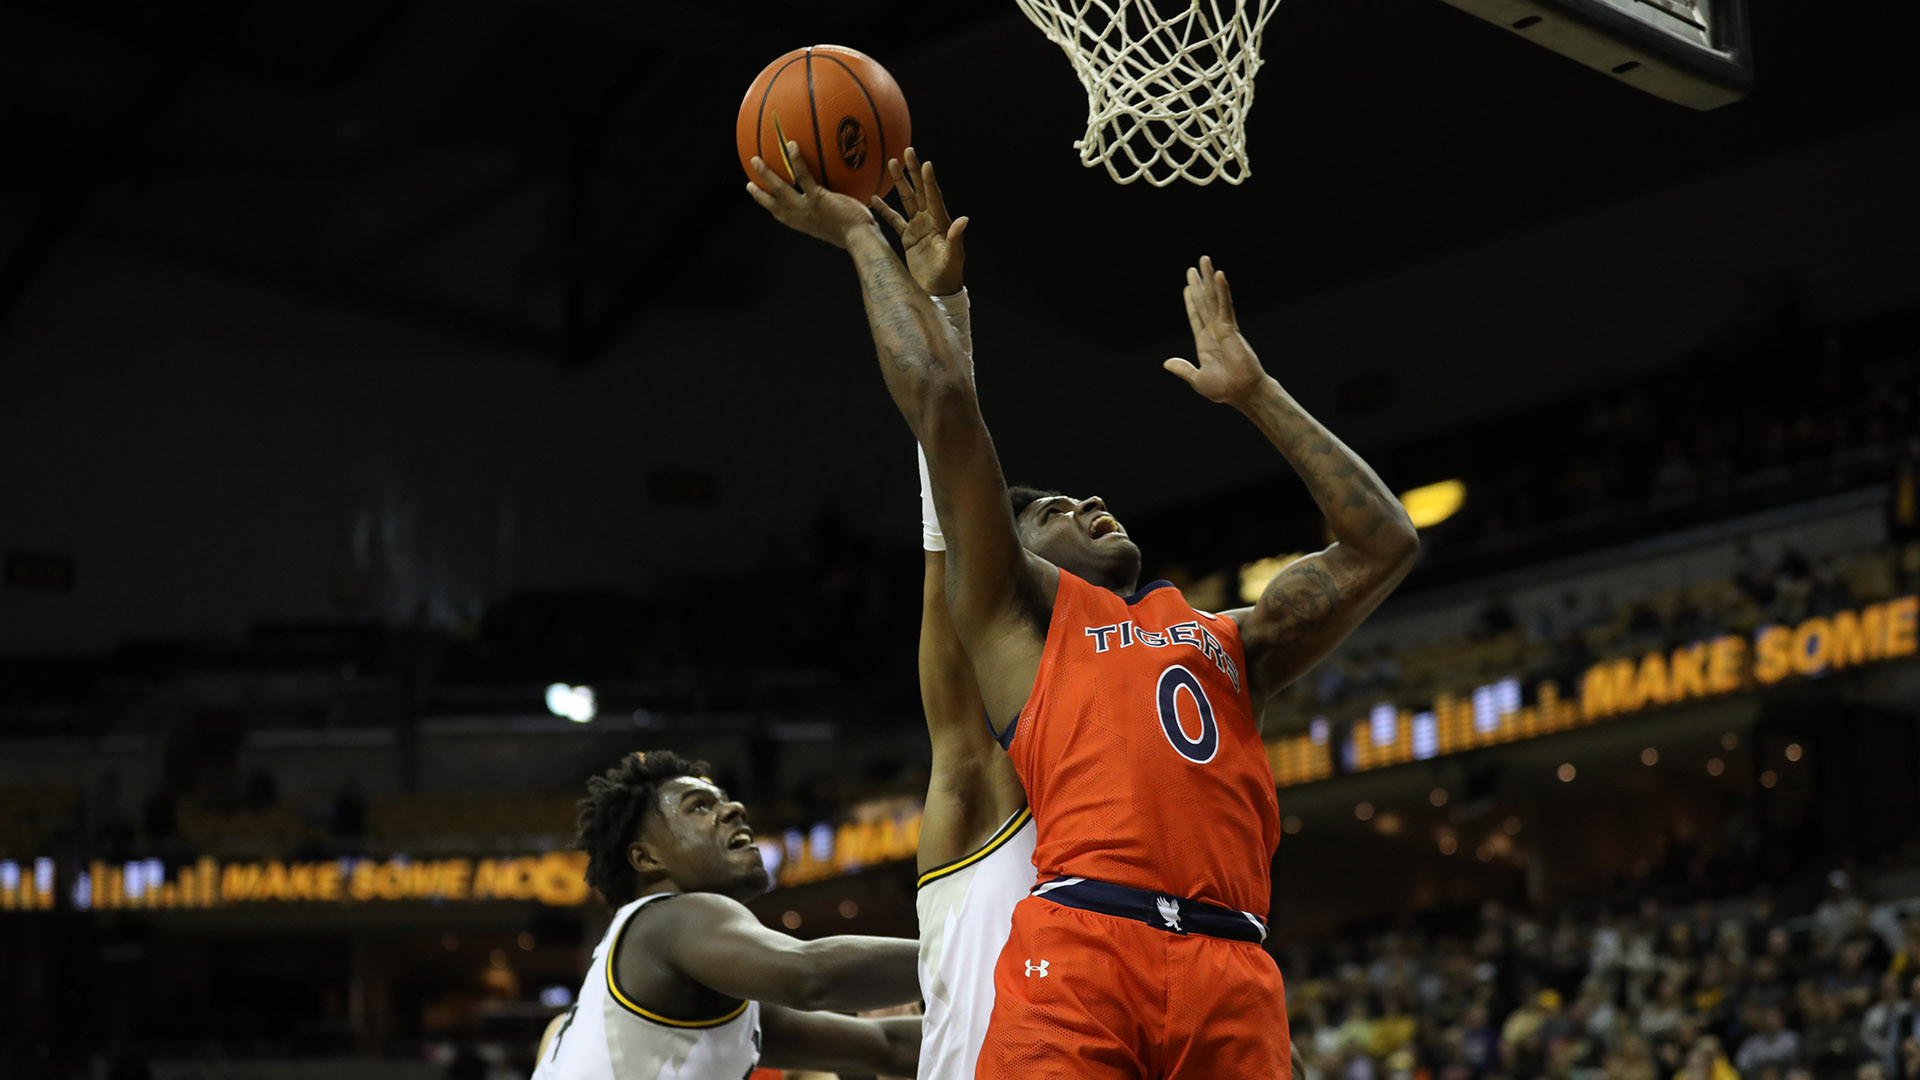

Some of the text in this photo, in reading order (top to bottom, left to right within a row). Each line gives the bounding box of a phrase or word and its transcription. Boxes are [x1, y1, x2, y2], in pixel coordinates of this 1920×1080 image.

[1085, 620, 1241, 694] TIGERS
[1580, 595, 1919, 722] MAKE SOME
[1156, 664, 1219, 765] 0
[221, 859, 340, 901] MAKE
[349, 857, 470, 901] SOME
